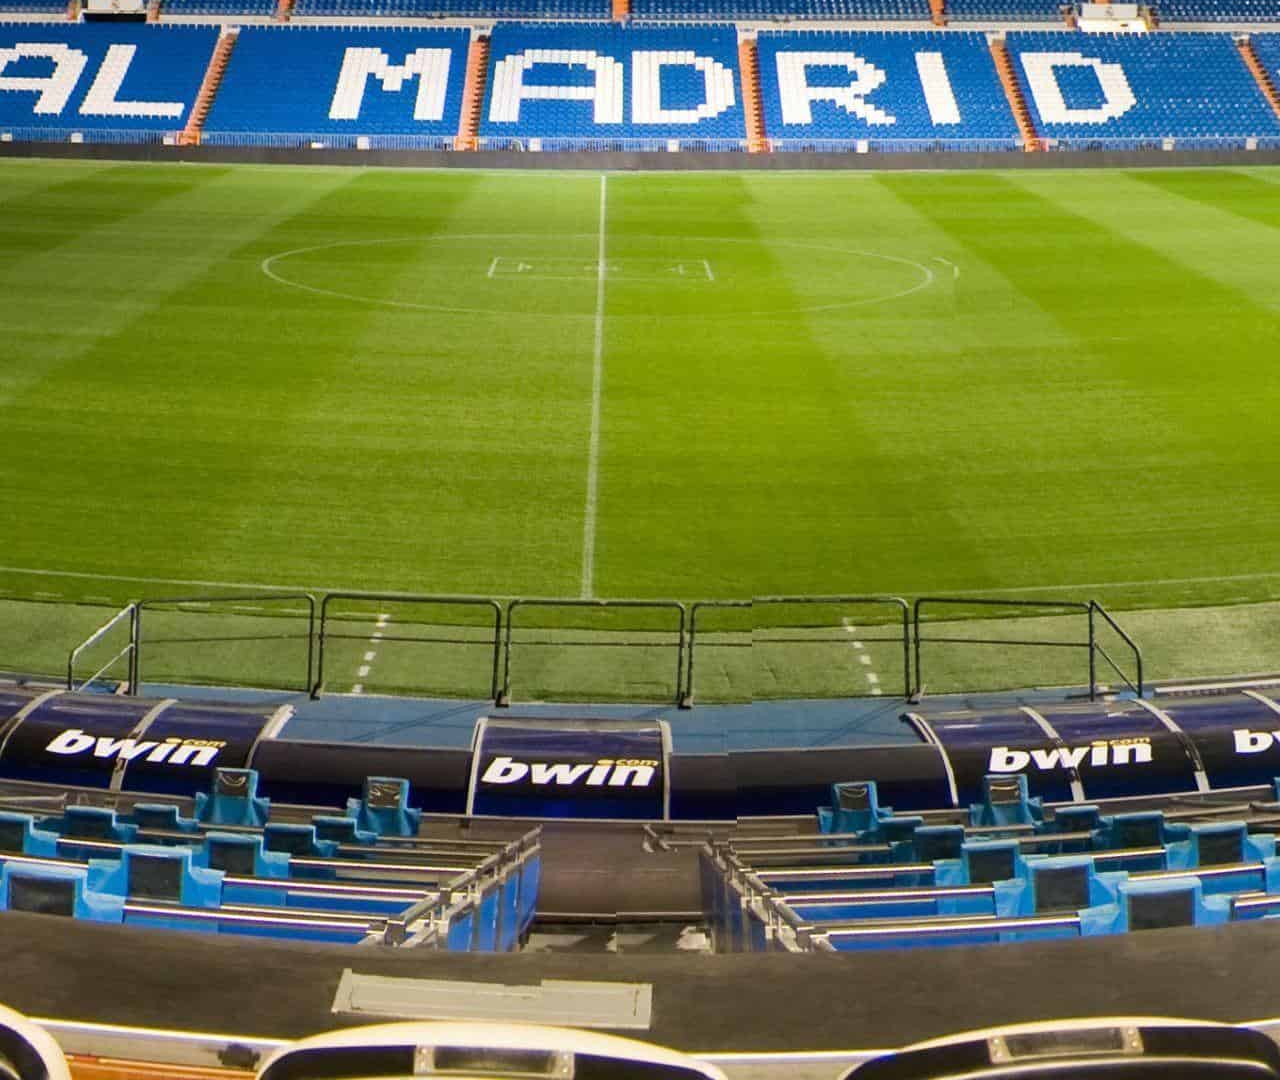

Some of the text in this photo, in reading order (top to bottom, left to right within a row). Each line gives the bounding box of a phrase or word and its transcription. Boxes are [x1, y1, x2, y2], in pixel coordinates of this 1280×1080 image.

[329, 47, 1137, 124] MADRID
[45, 728, 220, 766] bwin
[989, 741, 1153, 772] bwin
[481, 757, 656, 787] bwin
